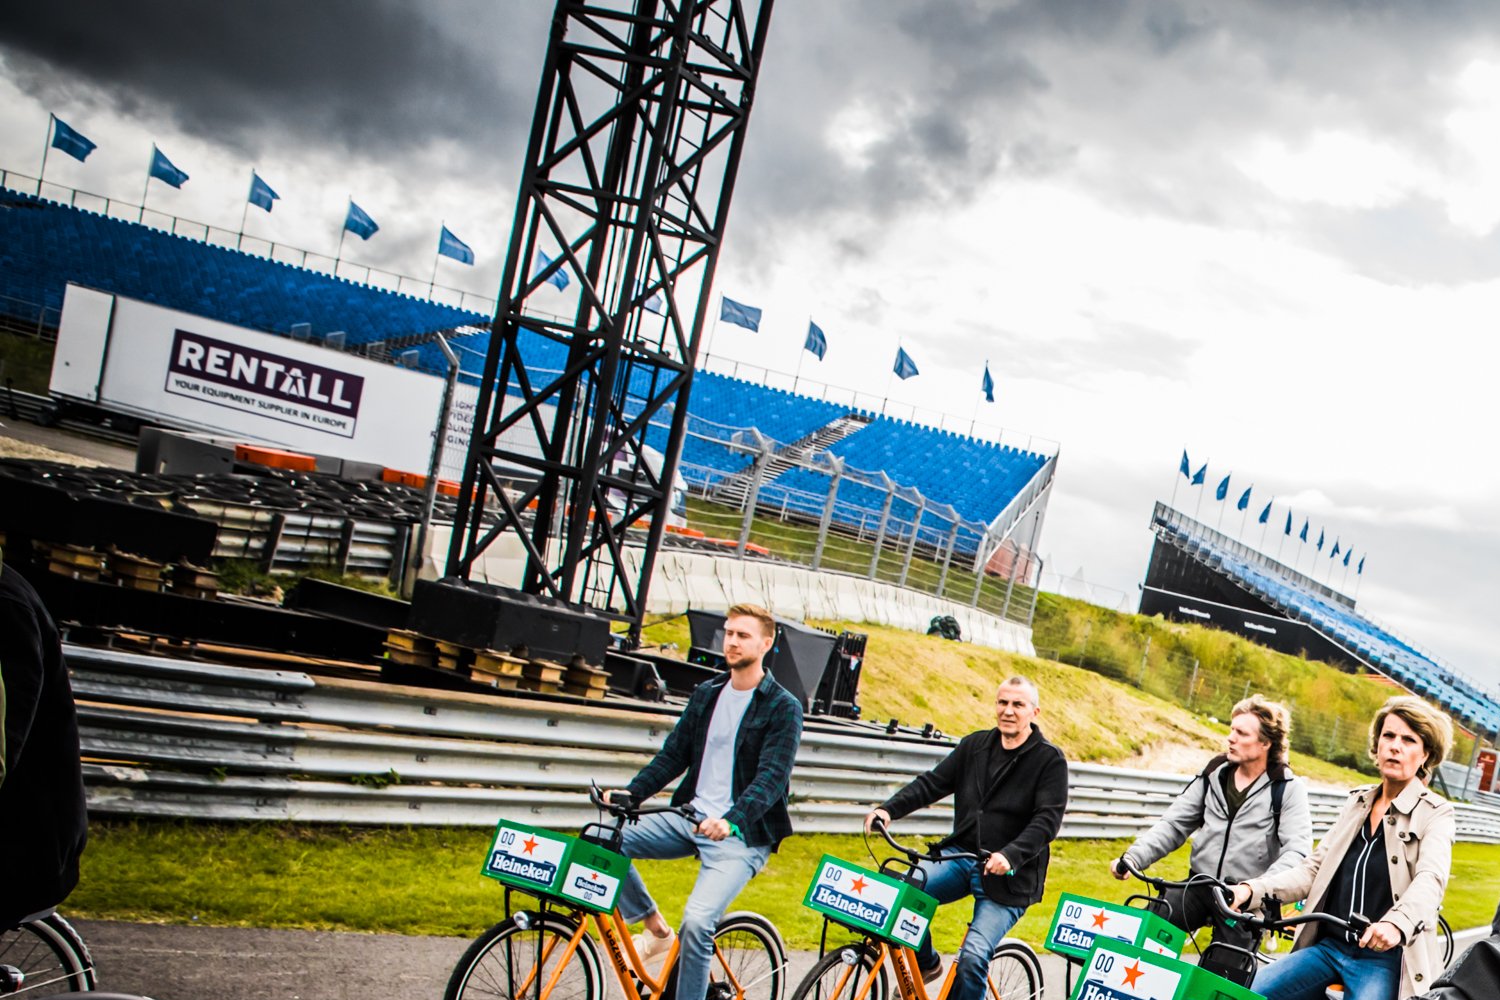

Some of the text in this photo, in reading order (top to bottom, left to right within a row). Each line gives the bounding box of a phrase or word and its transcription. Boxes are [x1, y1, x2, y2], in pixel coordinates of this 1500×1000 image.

[177, 338, 353, 410] RENTALL
[174, 378, 348, 430] YOUR EQUIPMENT SUPPLIER IN EUROPE
[1057, 928, 1094, 947] Hein
[1094, 953, 1115, 974] 0.0
